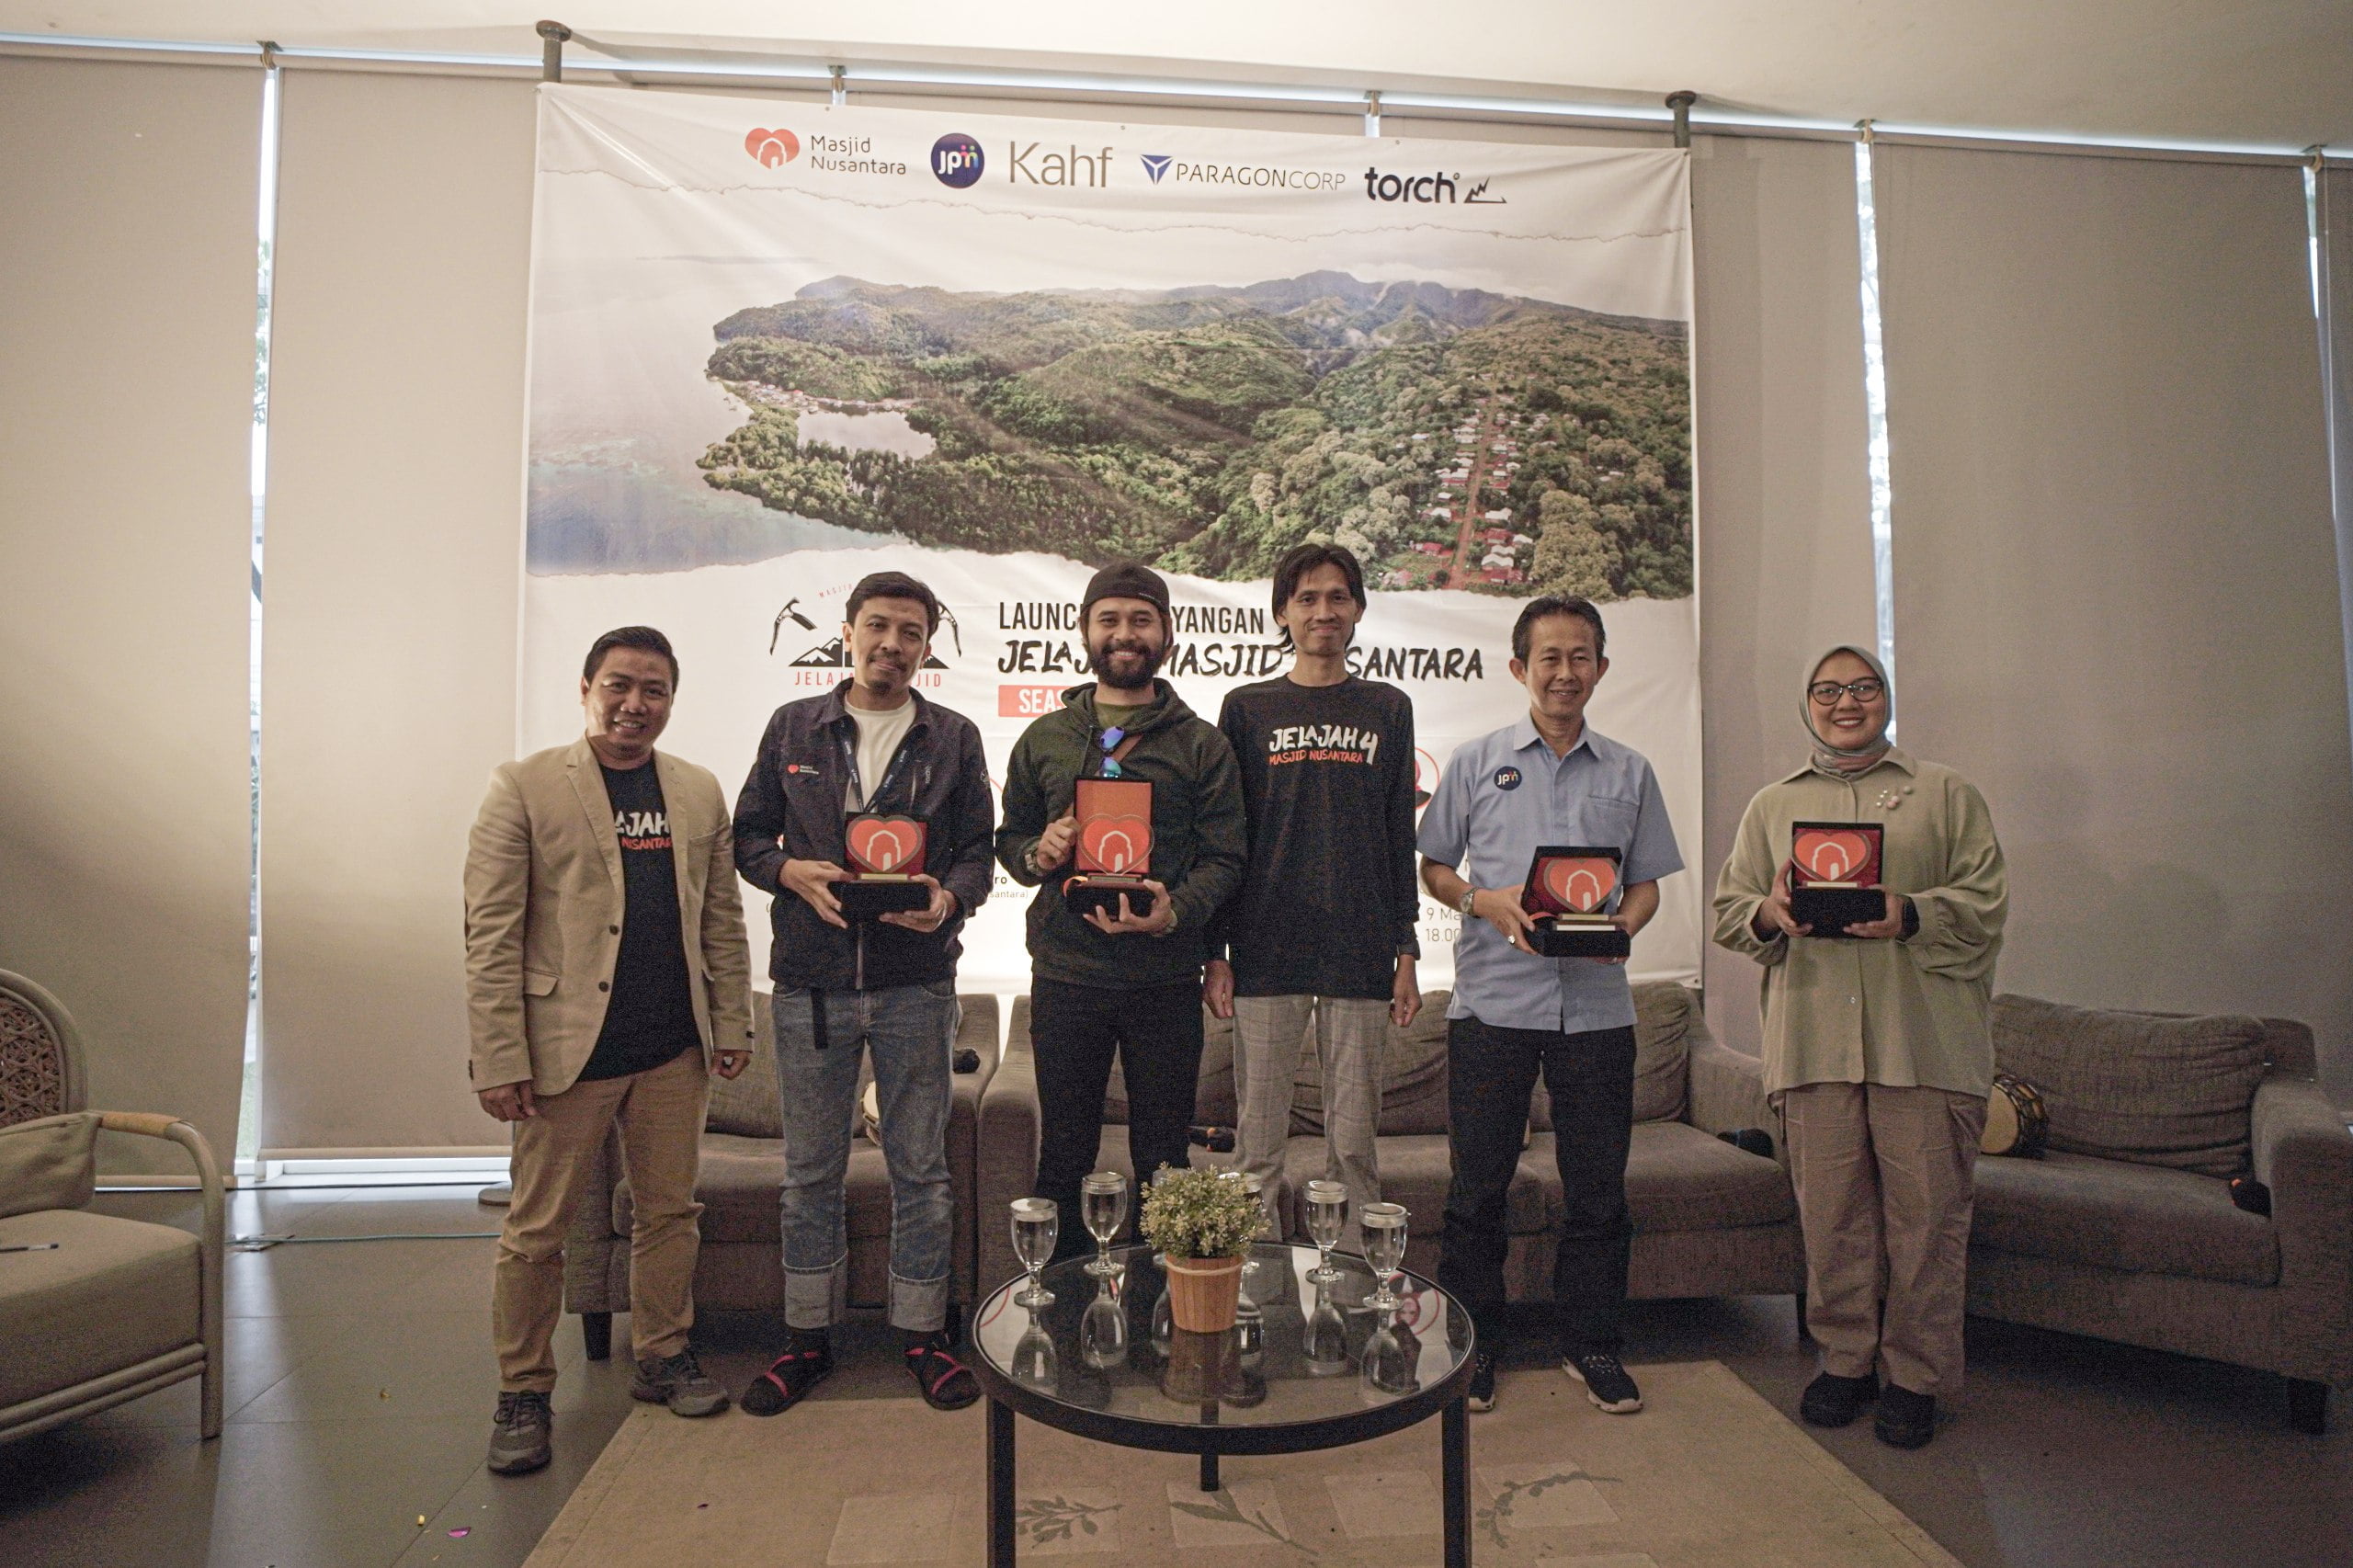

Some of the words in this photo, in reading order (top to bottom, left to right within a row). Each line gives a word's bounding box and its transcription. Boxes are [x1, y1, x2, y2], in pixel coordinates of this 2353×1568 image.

[811, 135, 870, 156] Masjid
[811, 155, 906, 175] Nusantara
[1009, 141, 1113, 187] Kahf
[1176, 163, 1346, 190] PARAGONCORP
[1365, 167, 1456, 203] torch
[999, 601, 1080, 631] LAUNC
[1171, 606, 1265, 634] YANGAN
[997, 640, 1094, 675] JELAJ
[1345, 646, 1483, 682] SANTARA
[1018, 688, 1064, 714] SEA
[1268, 724, 1358, 752] JELAJAH
[1359, 731, 1378, 765] 4
[1269, 749, 1306, 766] MASJID
[1309, 748, 1363, 764] NUSANTARA
[615, 810, 670, 837] AJAH
[989, 890, 1029, 899] santara)
[1427, 907, 1435, 921] 9
[1440, 907, 1462, 921] Ma
